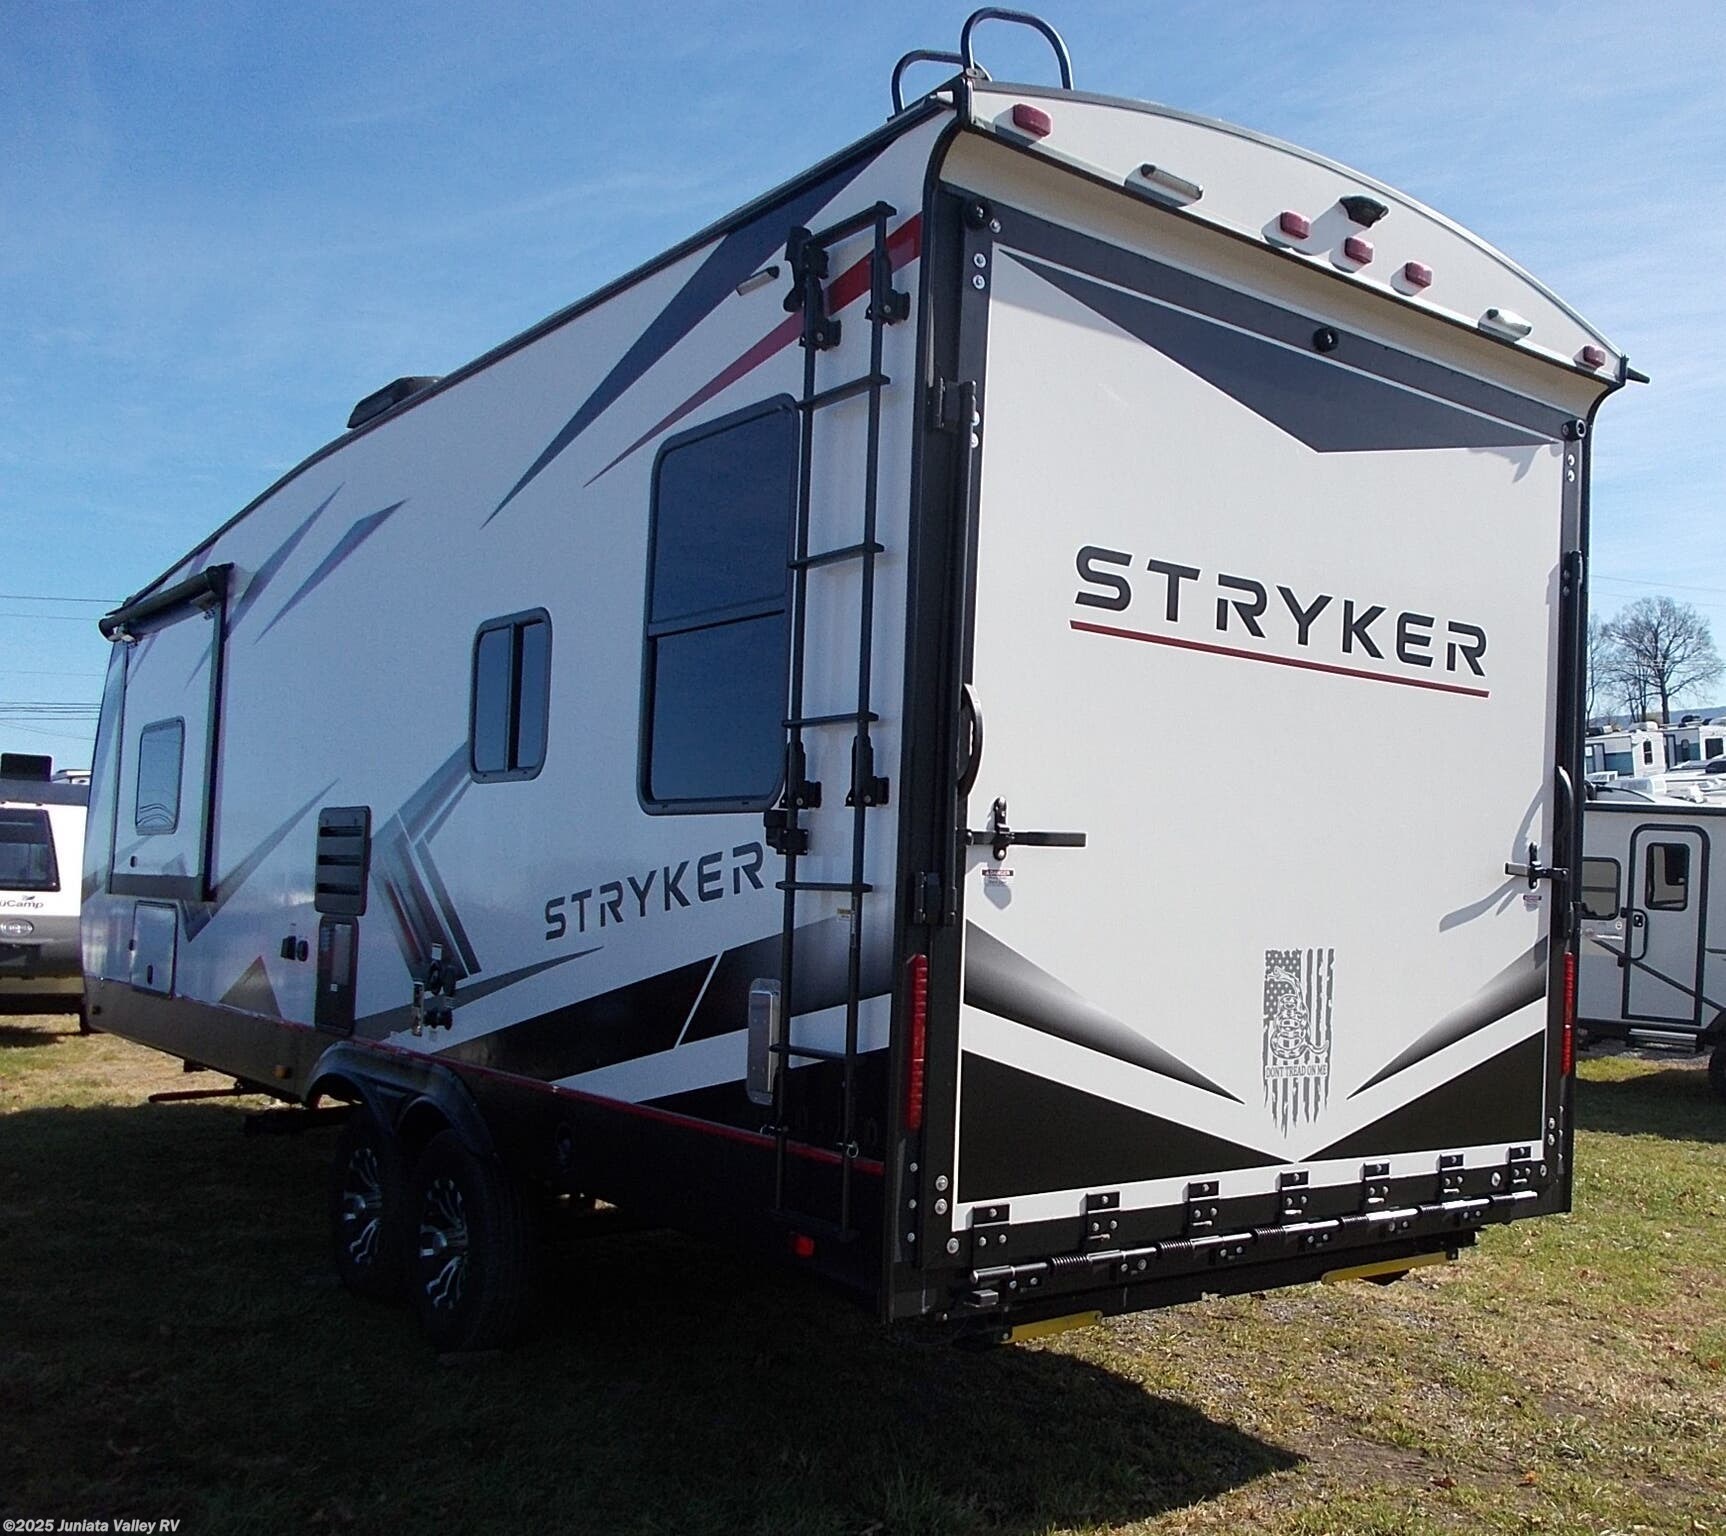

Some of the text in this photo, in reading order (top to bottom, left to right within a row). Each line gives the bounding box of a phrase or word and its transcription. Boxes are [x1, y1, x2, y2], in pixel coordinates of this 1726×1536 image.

[1075, 545, 1487, 677] STRYKER
[545, 841, 765, 941] STRYKER
[1285, 1066, 1306, 1077] TREAD
[1307, 1065, 1317, 1076] ON
[1317, 1064, 1328, 1075] ME
